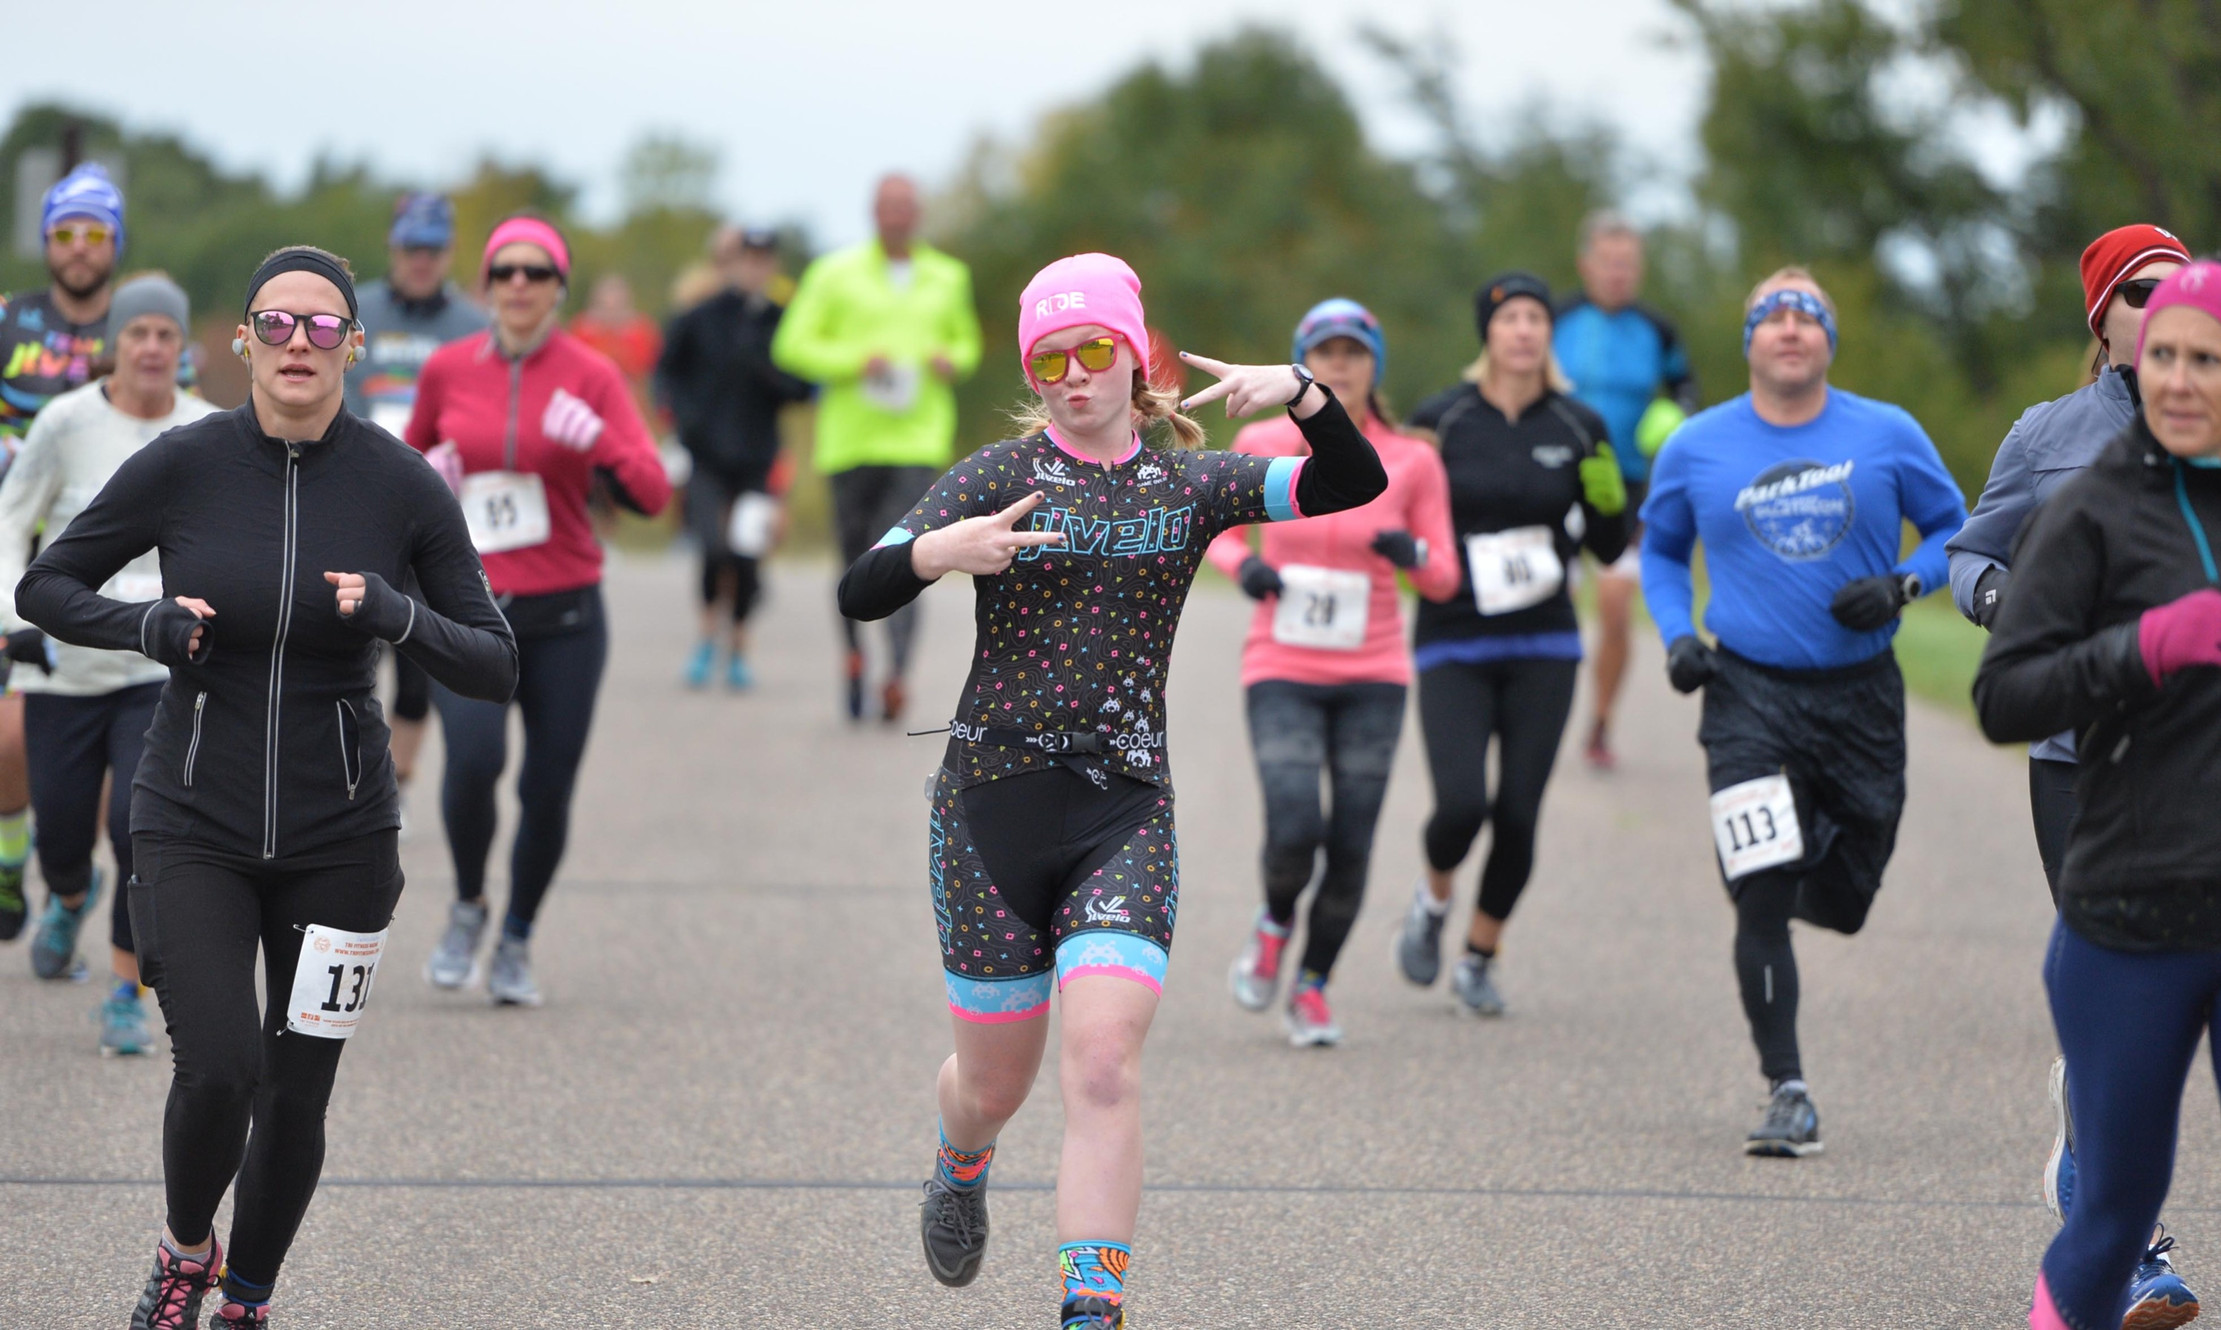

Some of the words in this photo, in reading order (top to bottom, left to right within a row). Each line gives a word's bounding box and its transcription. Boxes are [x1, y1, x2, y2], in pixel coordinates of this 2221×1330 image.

[951, 720, 988, 742] oeur
[1116, 731, 1164, 750] coeur
[1725, 805, 1777, 852] 113
[321, 962, 375, 1012] 131
